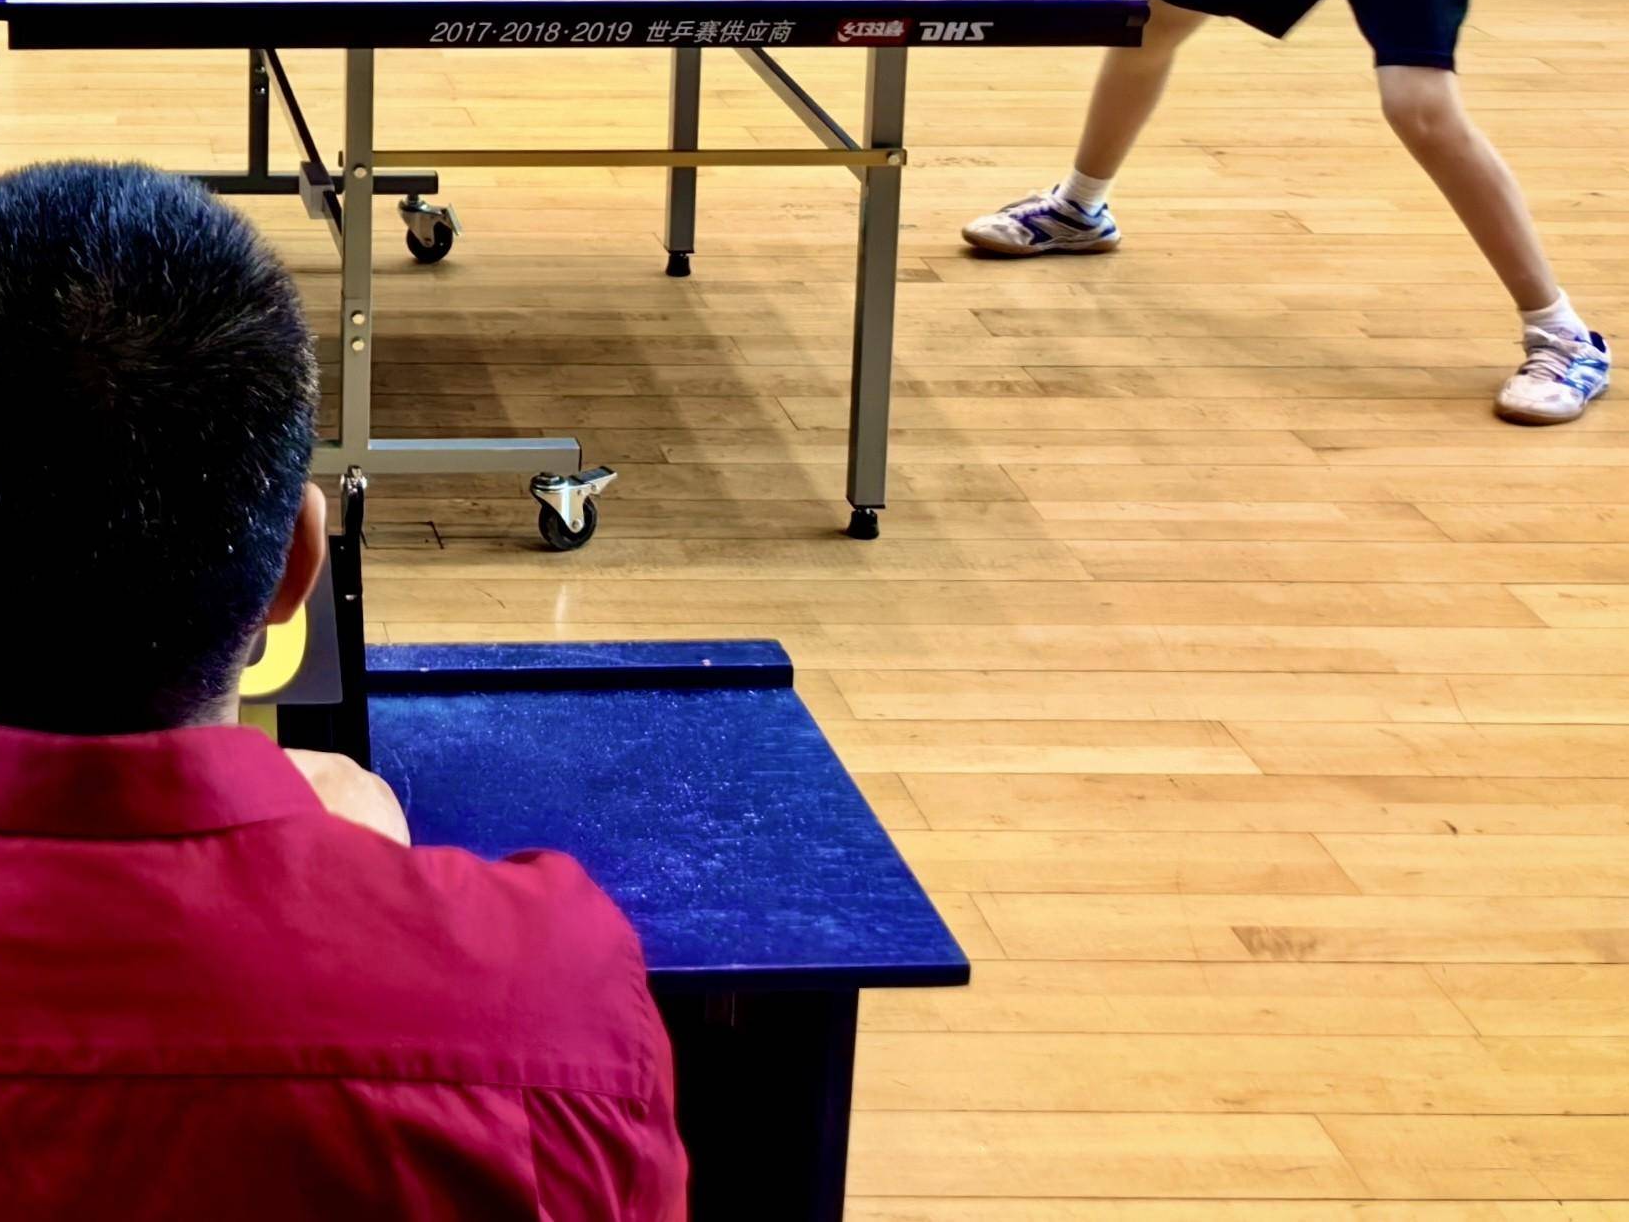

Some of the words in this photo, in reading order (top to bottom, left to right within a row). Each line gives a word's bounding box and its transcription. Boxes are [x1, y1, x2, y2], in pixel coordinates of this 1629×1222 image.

[646, 20, 797, 44] 世乒赛供应商
[919, 21, 995, 41] DHS
